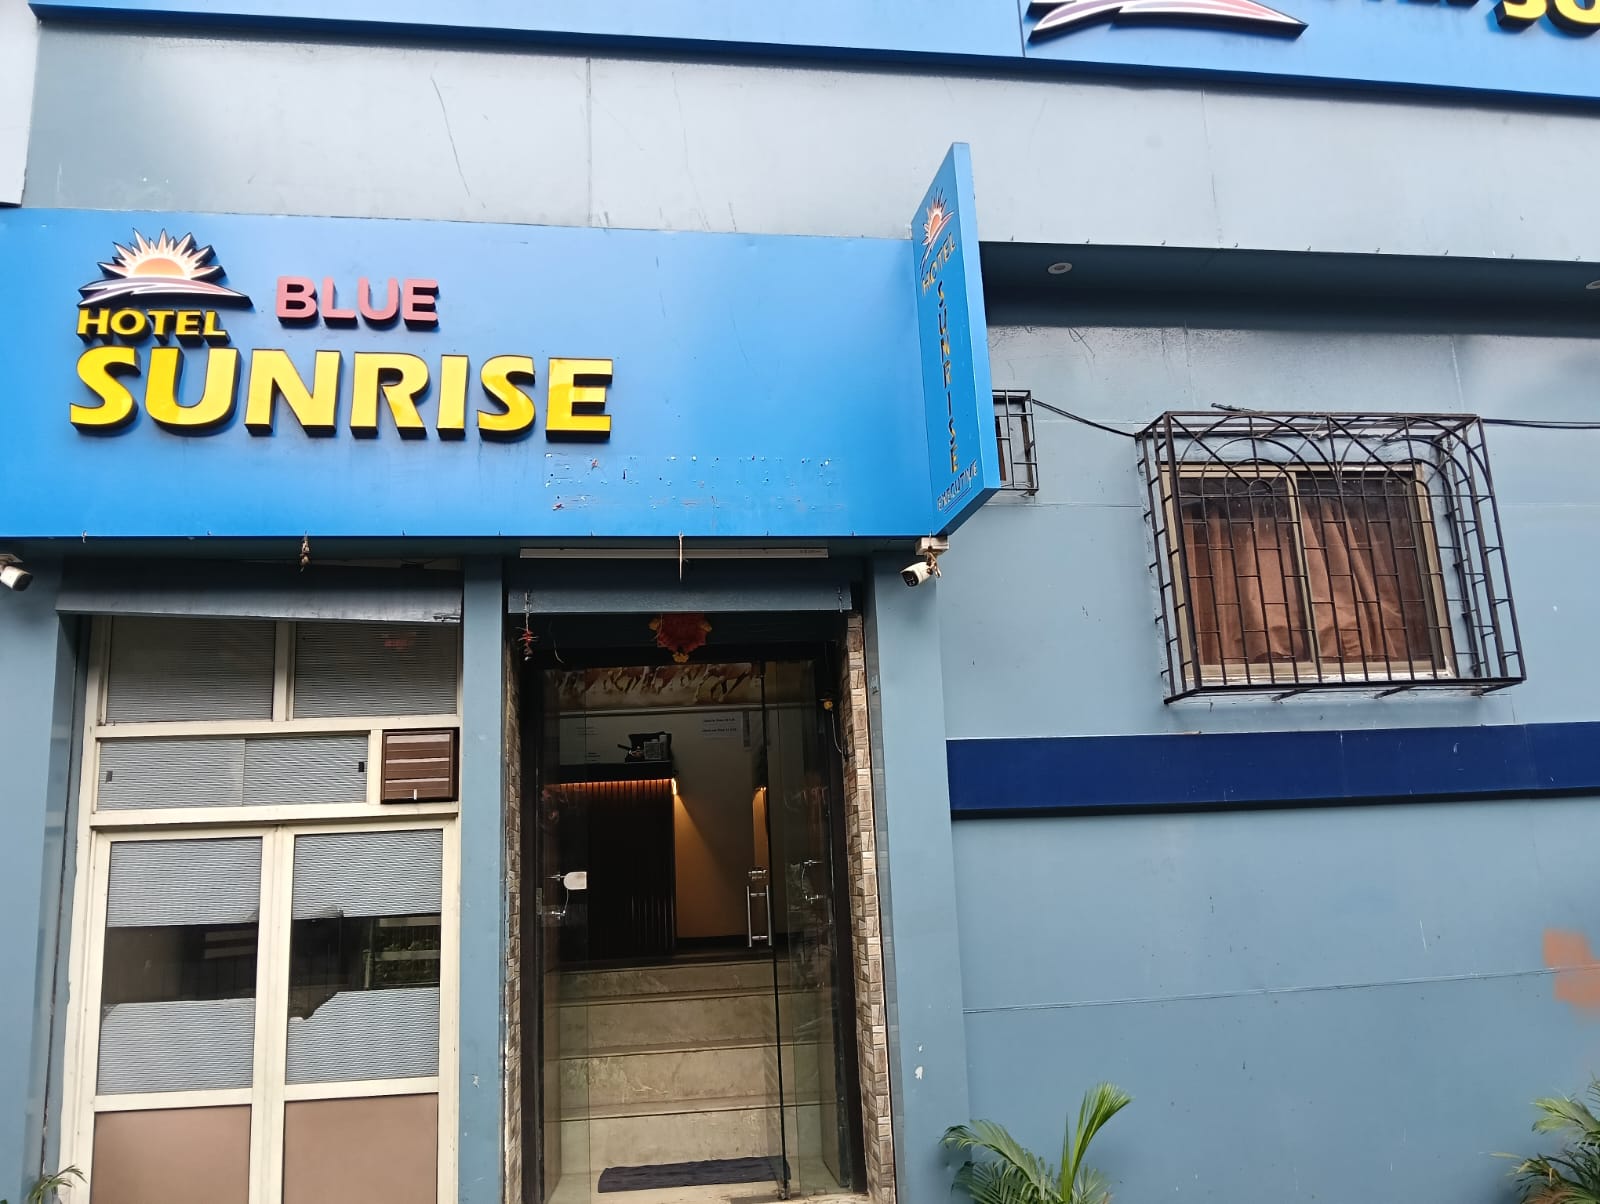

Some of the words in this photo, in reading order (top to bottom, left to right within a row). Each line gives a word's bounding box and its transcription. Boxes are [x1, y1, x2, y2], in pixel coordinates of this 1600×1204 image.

[922, 231, 956, 297] HOTEL
[76, 308, 228, 340] HOTEL
[275, 276, 438, 324] BLUE
[70, 345, 613, 437] SUNRISE
[938, 279, 958, 474] SUNRISE
[937, 459, 977, 511] EXECUTIVE
